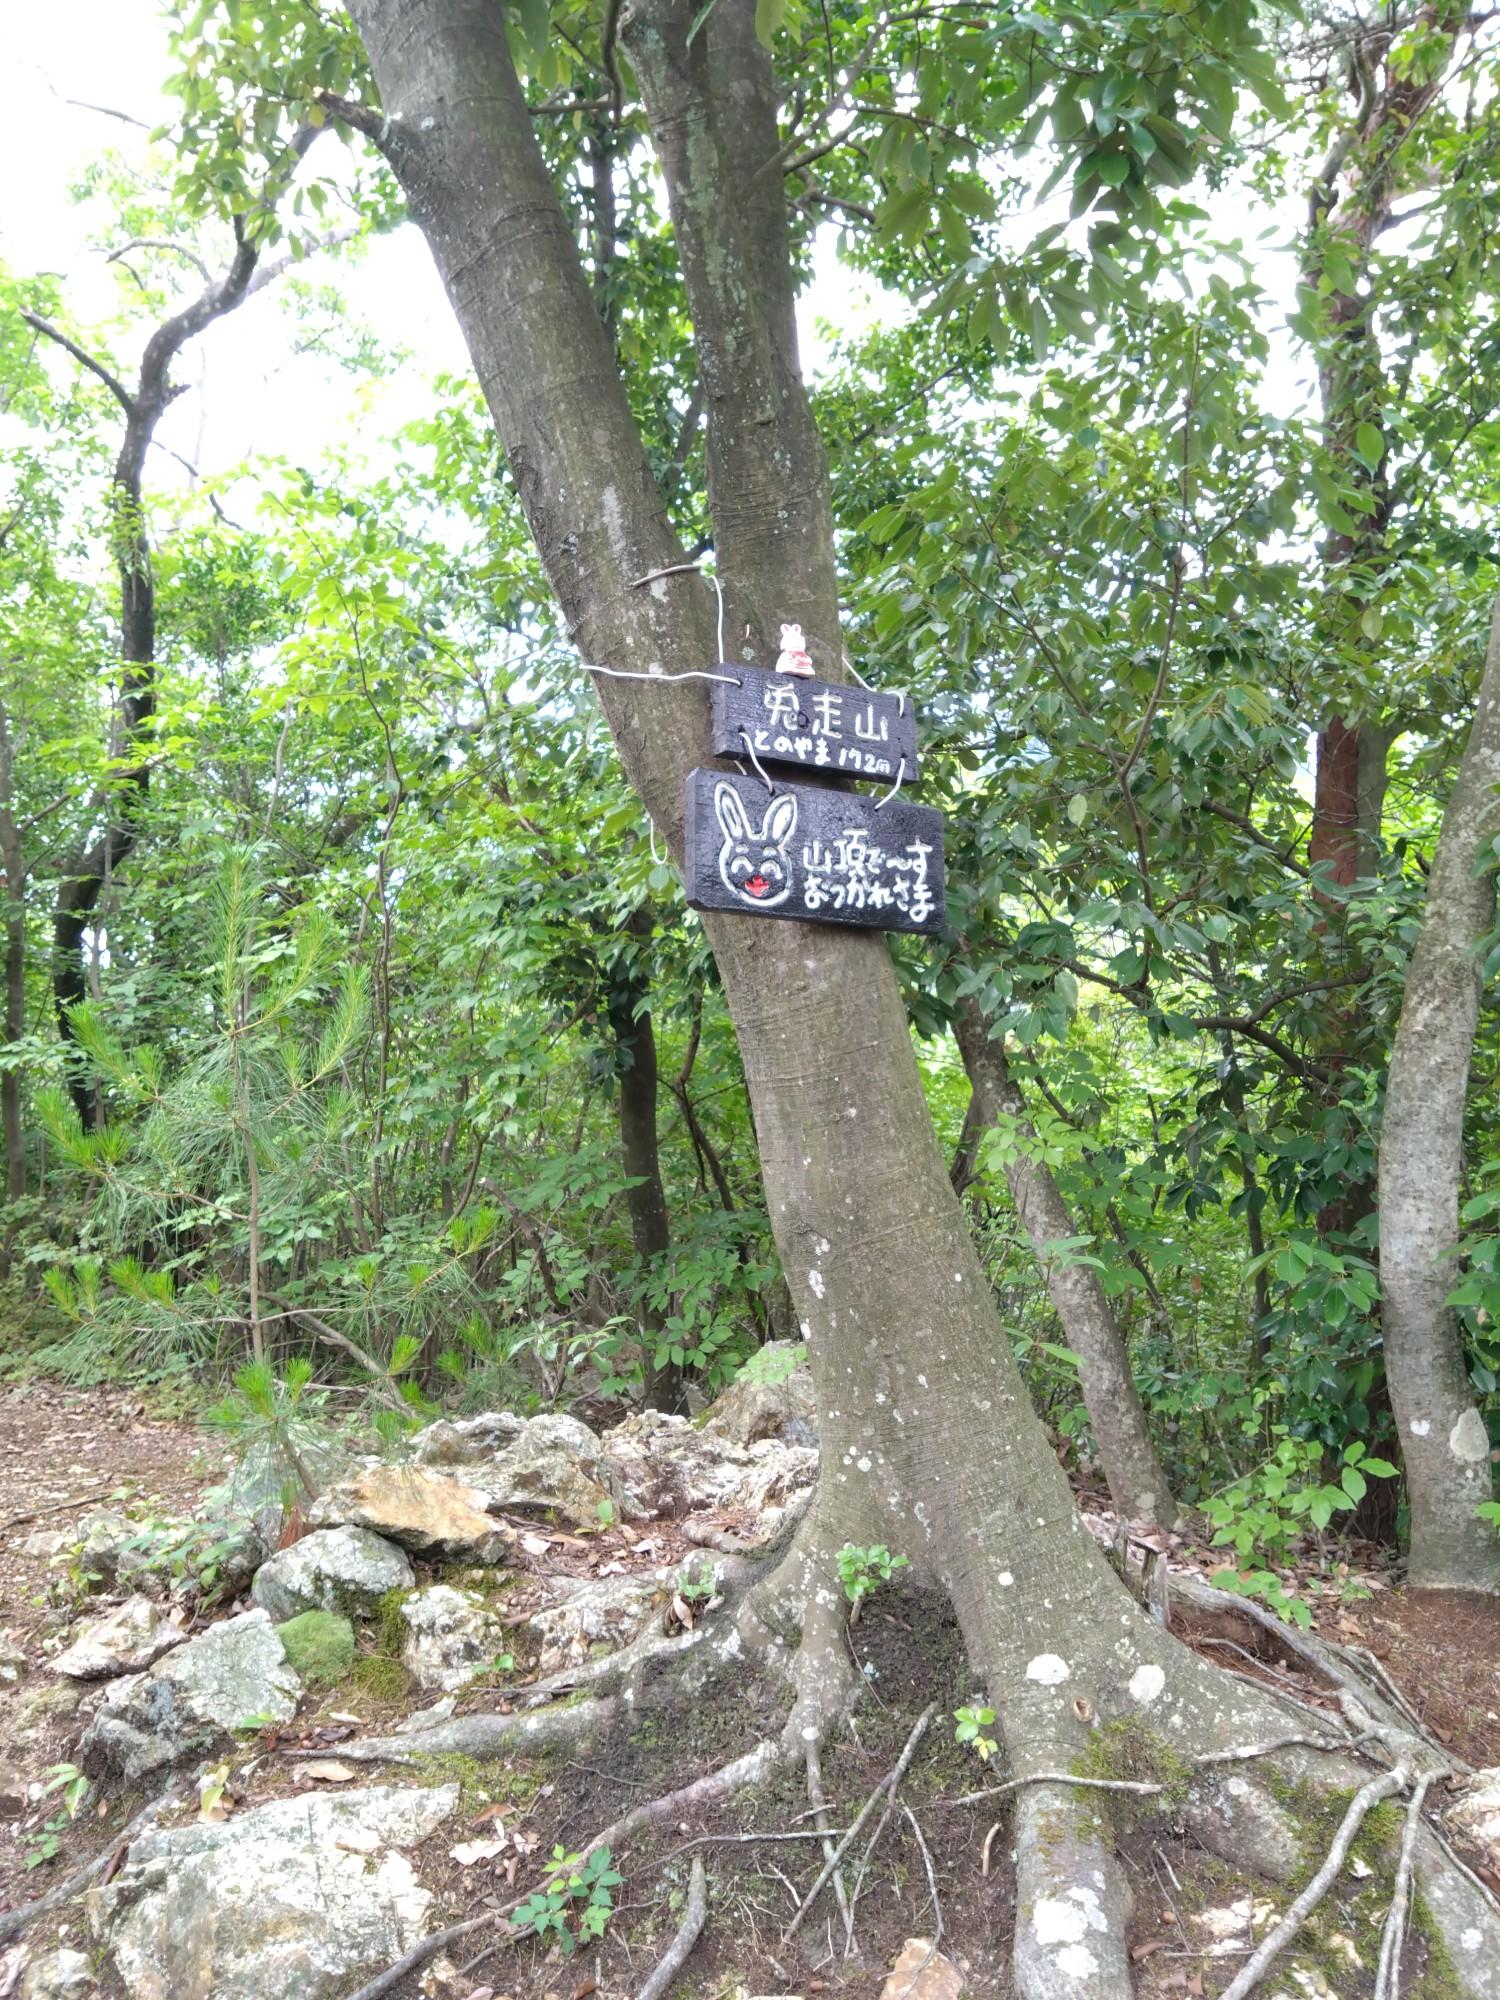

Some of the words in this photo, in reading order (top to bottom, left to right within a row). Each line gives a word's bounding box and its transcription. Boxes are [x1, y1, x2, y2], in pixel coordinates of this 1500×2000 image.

[754, 729, 831, 765] とのやま
[804, 873, 935, 923] おつかれさま
